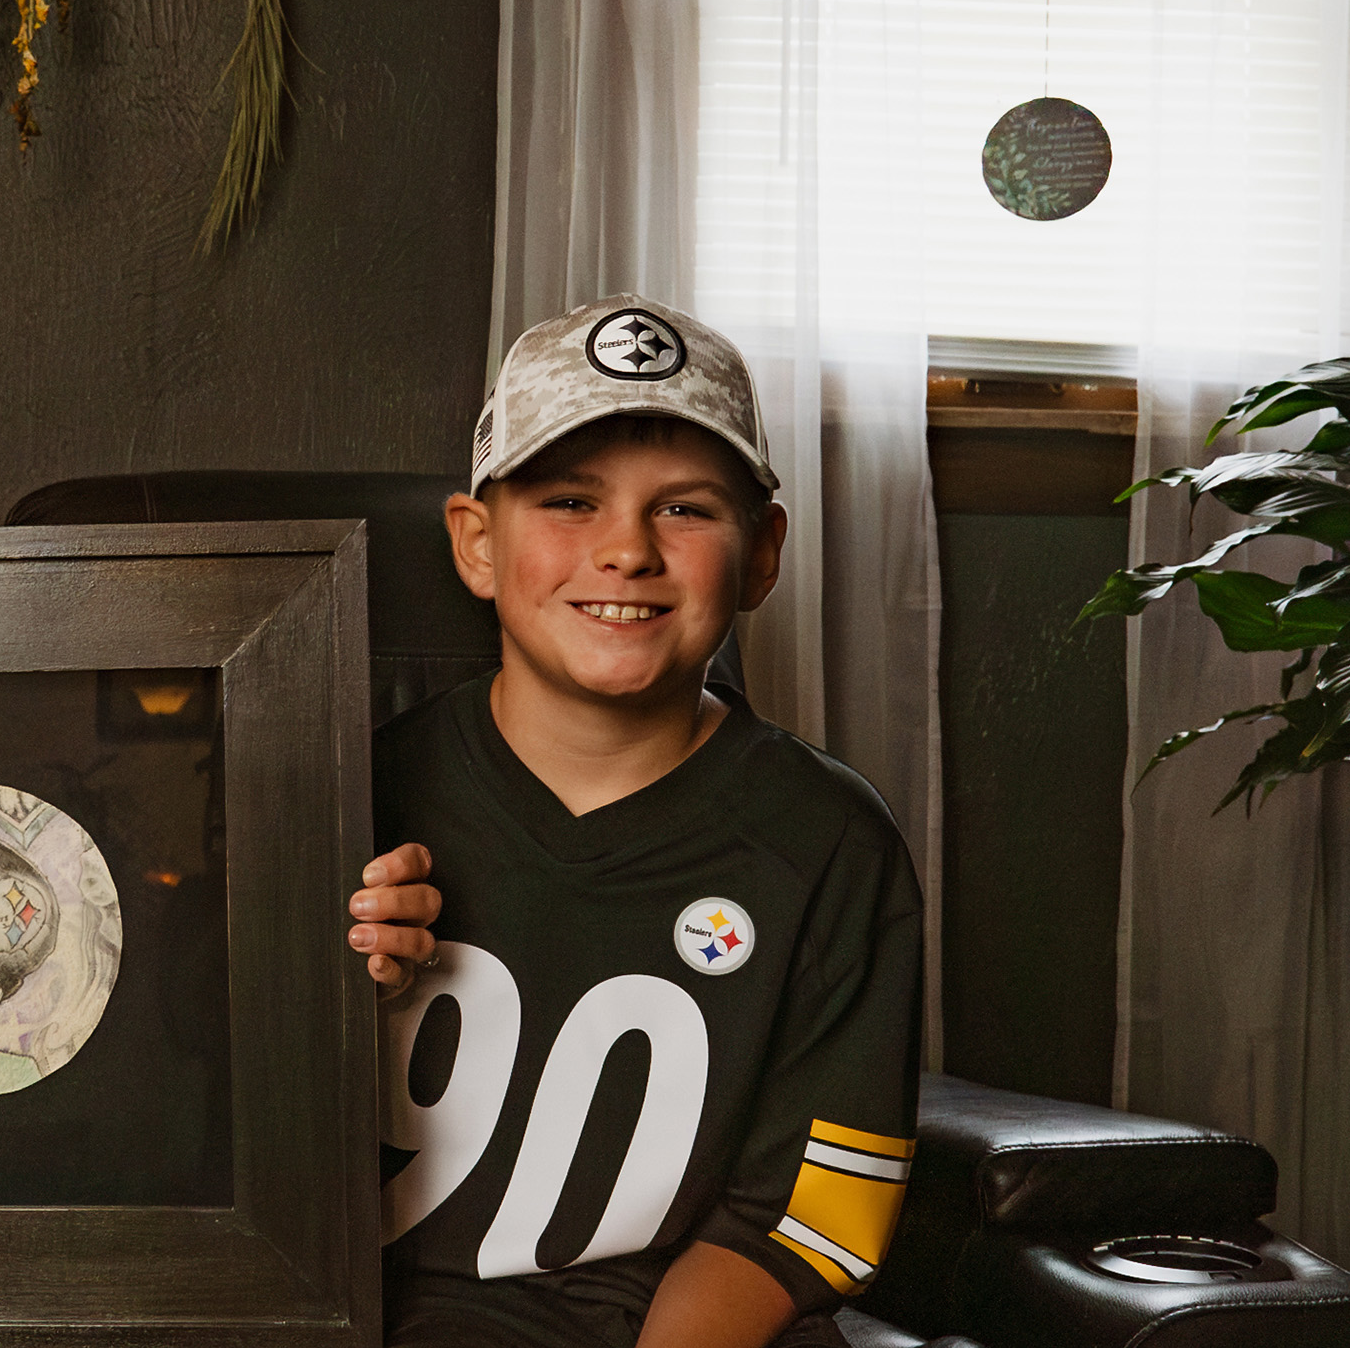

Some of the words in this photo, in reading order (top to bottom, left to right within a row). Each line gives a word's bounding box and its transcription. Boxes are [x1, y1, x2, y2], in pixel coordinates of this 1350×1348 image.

[597, 338, 634, 350] Steelers
[684, 924, 713, 938] Steelers
[377, 941, 709, 1280] 90
